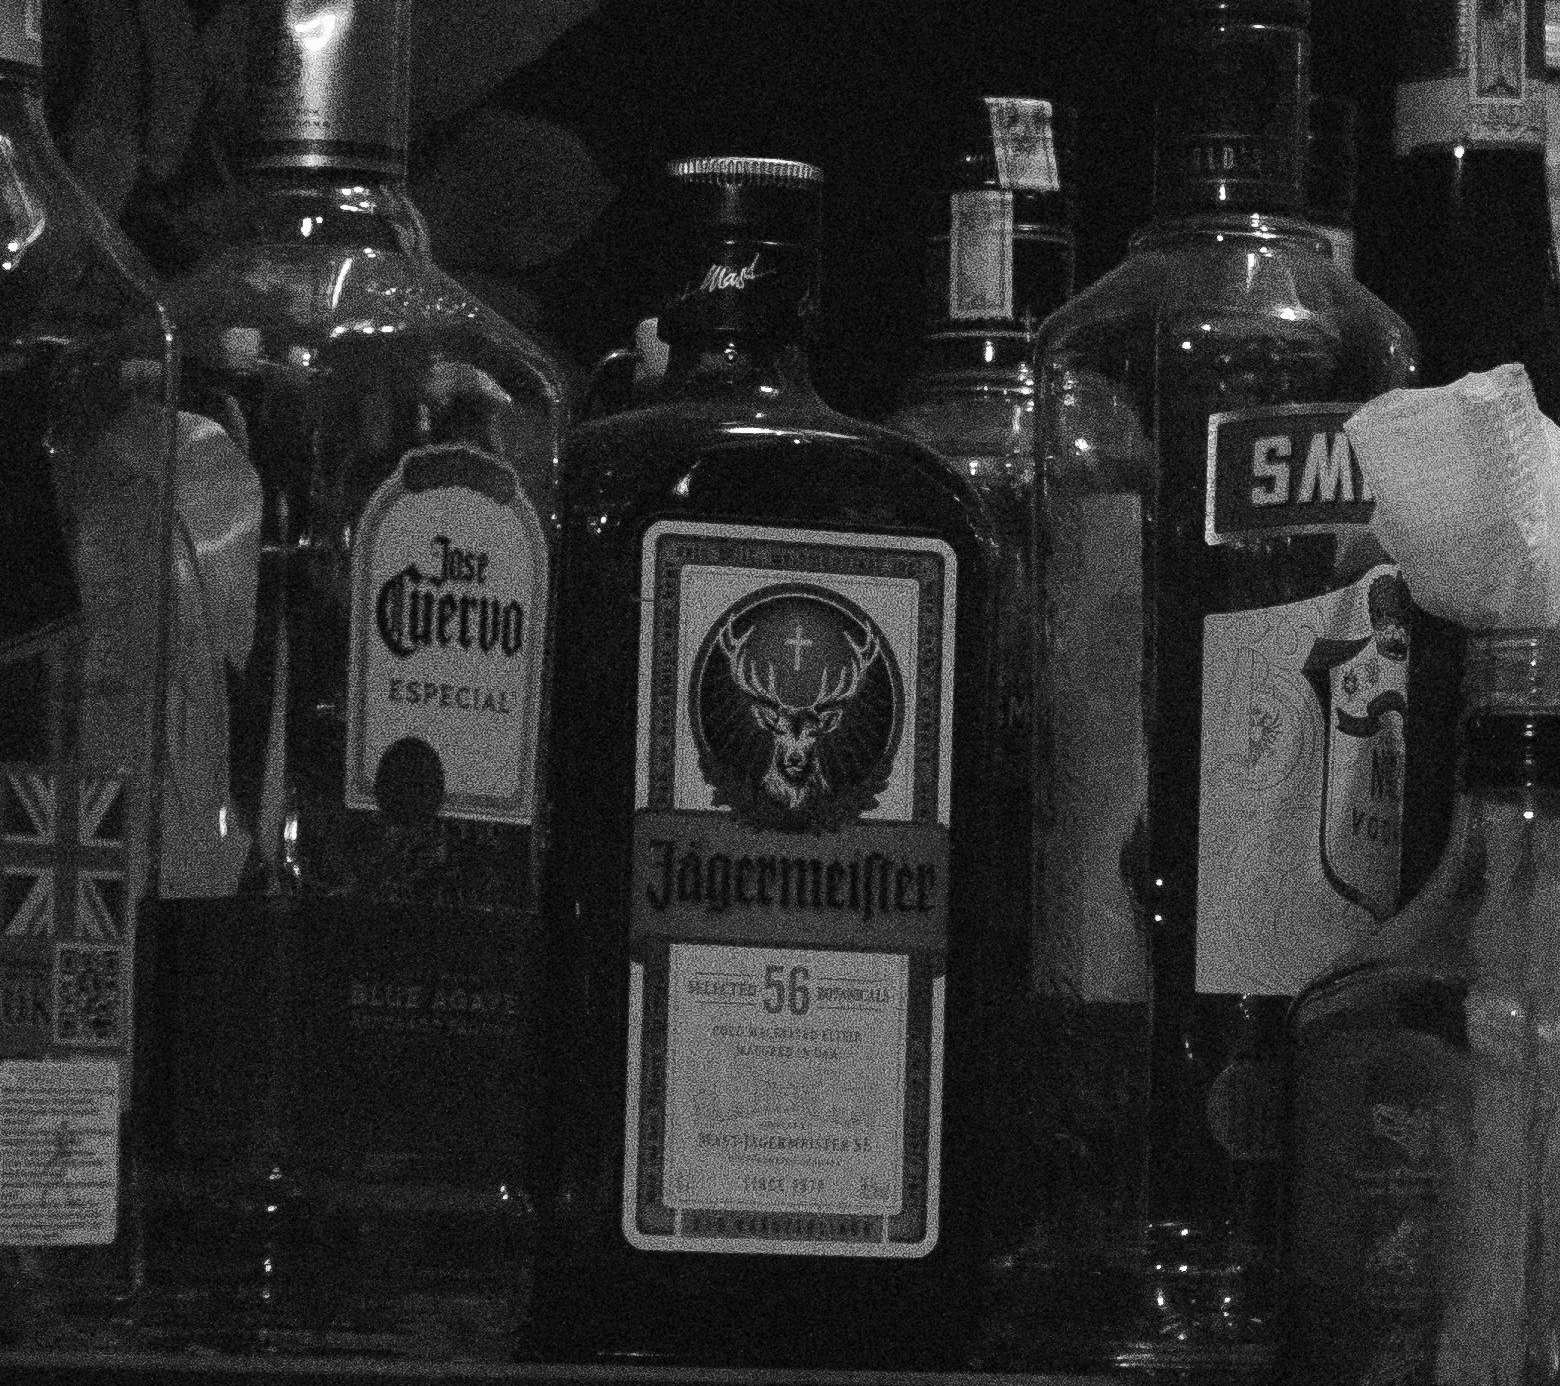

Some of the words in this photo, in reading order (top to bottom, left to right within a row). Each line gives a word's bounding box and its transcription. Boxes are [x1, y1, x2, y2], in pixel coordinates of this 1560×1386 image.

[376, 564, 523, 659] Cuervo
[388, 679, 510, 714] ESPECIAL
[350, 979, 423, 1010] BLUE
[688, 981, 758, 997] SELECTED
[764, 965, 811, 1015] 56
